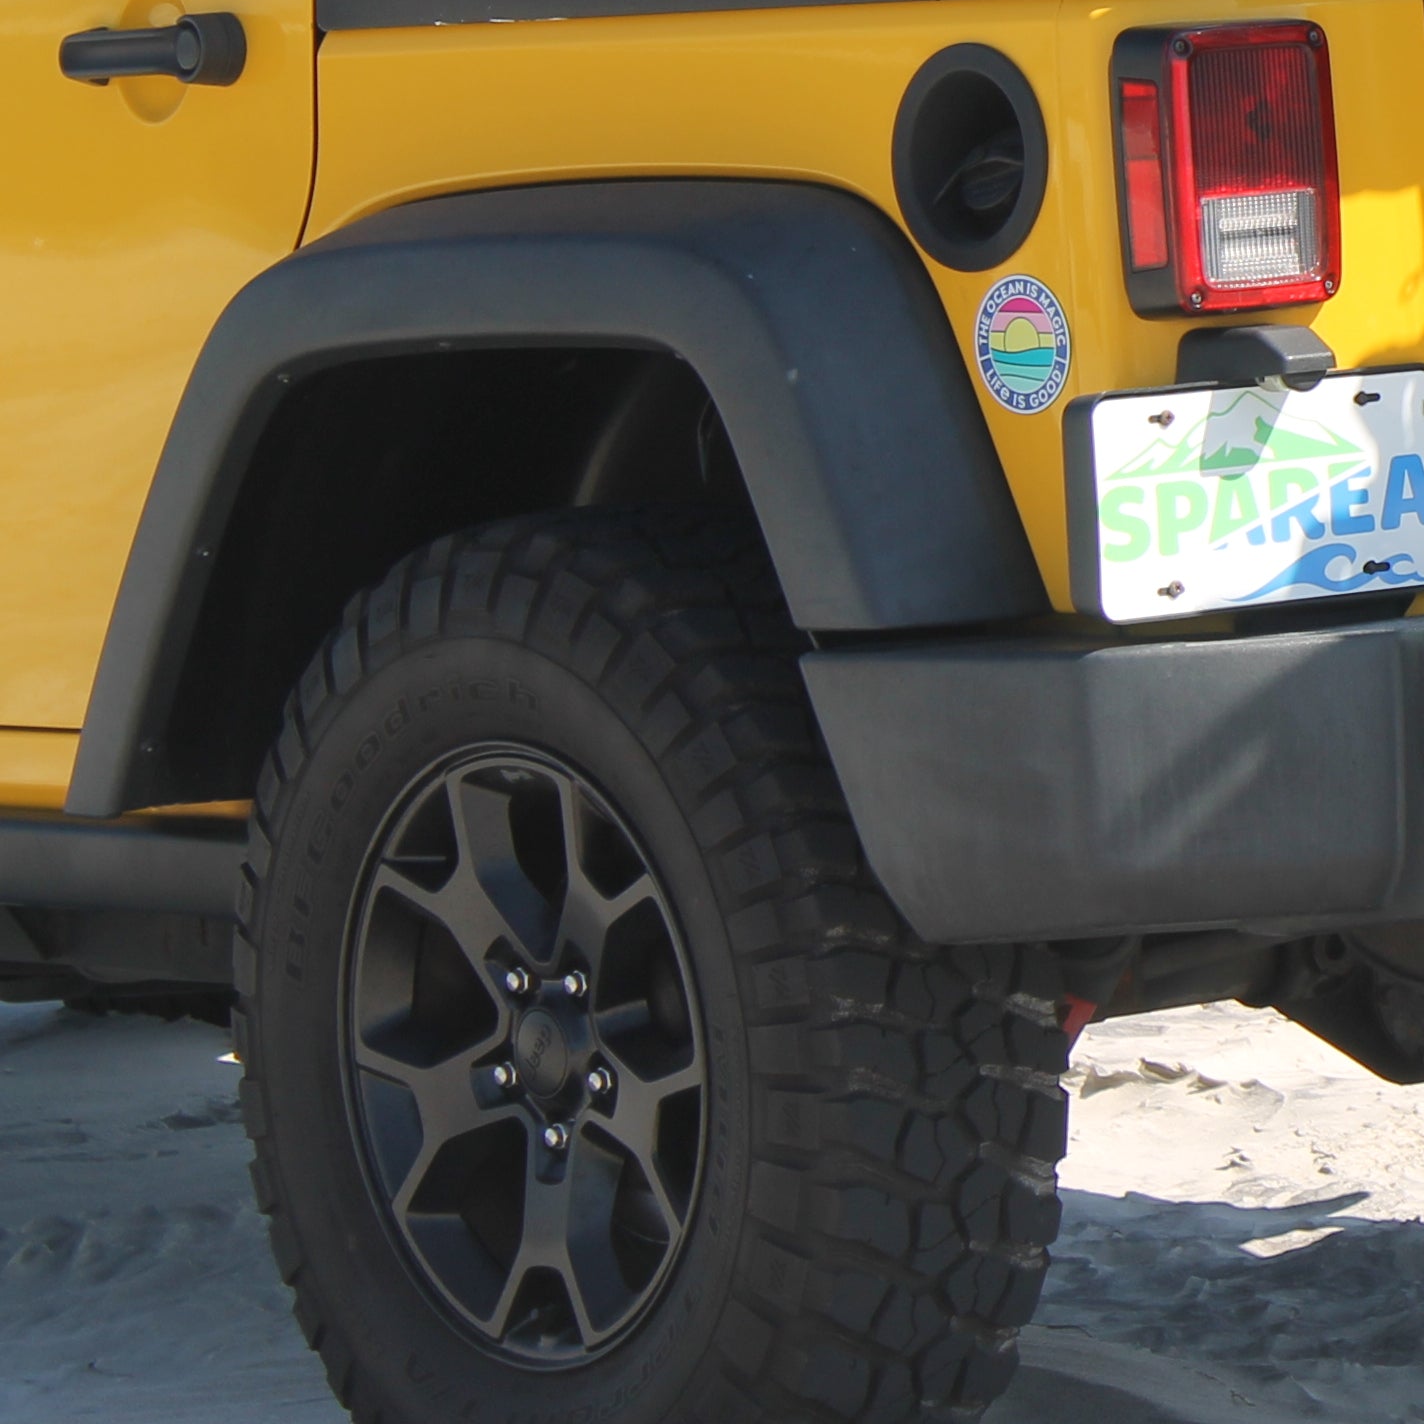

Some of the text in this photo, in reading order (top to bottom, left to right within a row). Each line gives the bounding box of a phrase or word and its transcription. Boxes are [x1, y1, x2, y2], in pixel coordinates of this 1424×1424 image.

[979, 281, 1066, 347] THE OCEAN IS MAGIC
[1012, 394, 1026, 408] IS
[1029, 370, 1062, 408] GOOD
